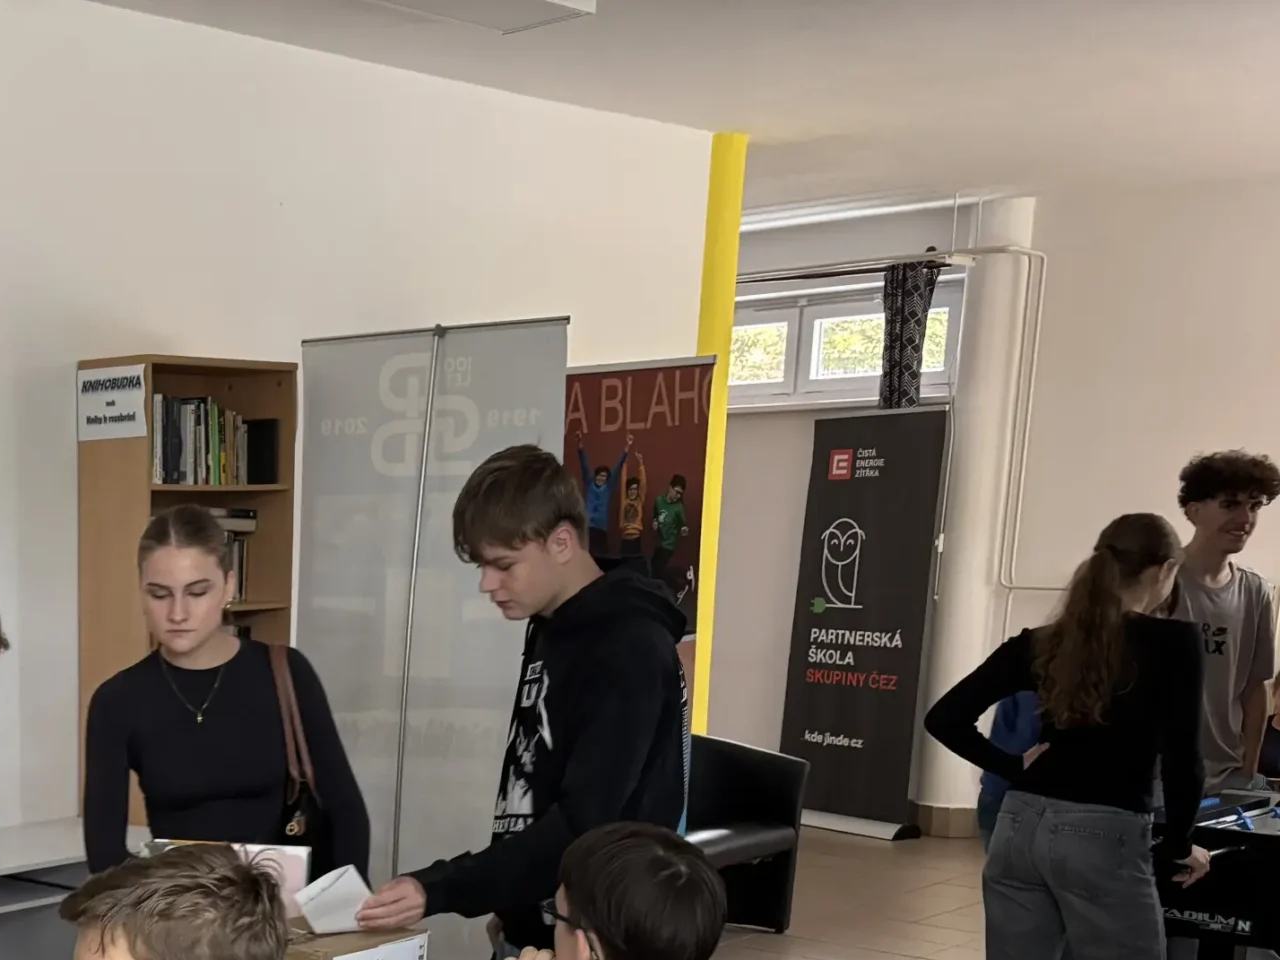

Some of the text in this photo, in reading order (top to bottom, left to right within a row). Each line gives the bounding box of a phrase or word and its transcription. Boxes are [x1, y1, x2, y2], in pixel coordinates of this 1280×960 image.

[81, 375, 142, 393] KNIHOBUDKA
[857, 447, 877, 458] ČISTÁ
[855, 458, 885, 468] ENERGIE
[854, 468, 880, 478] ZÍTŘKA
[809, 627, 903, 649] PARTNERSKÁ
[807, 645, 855, 666] ŠKOLA
[805, 668, 898, 690] SKUPINY ČEZ
